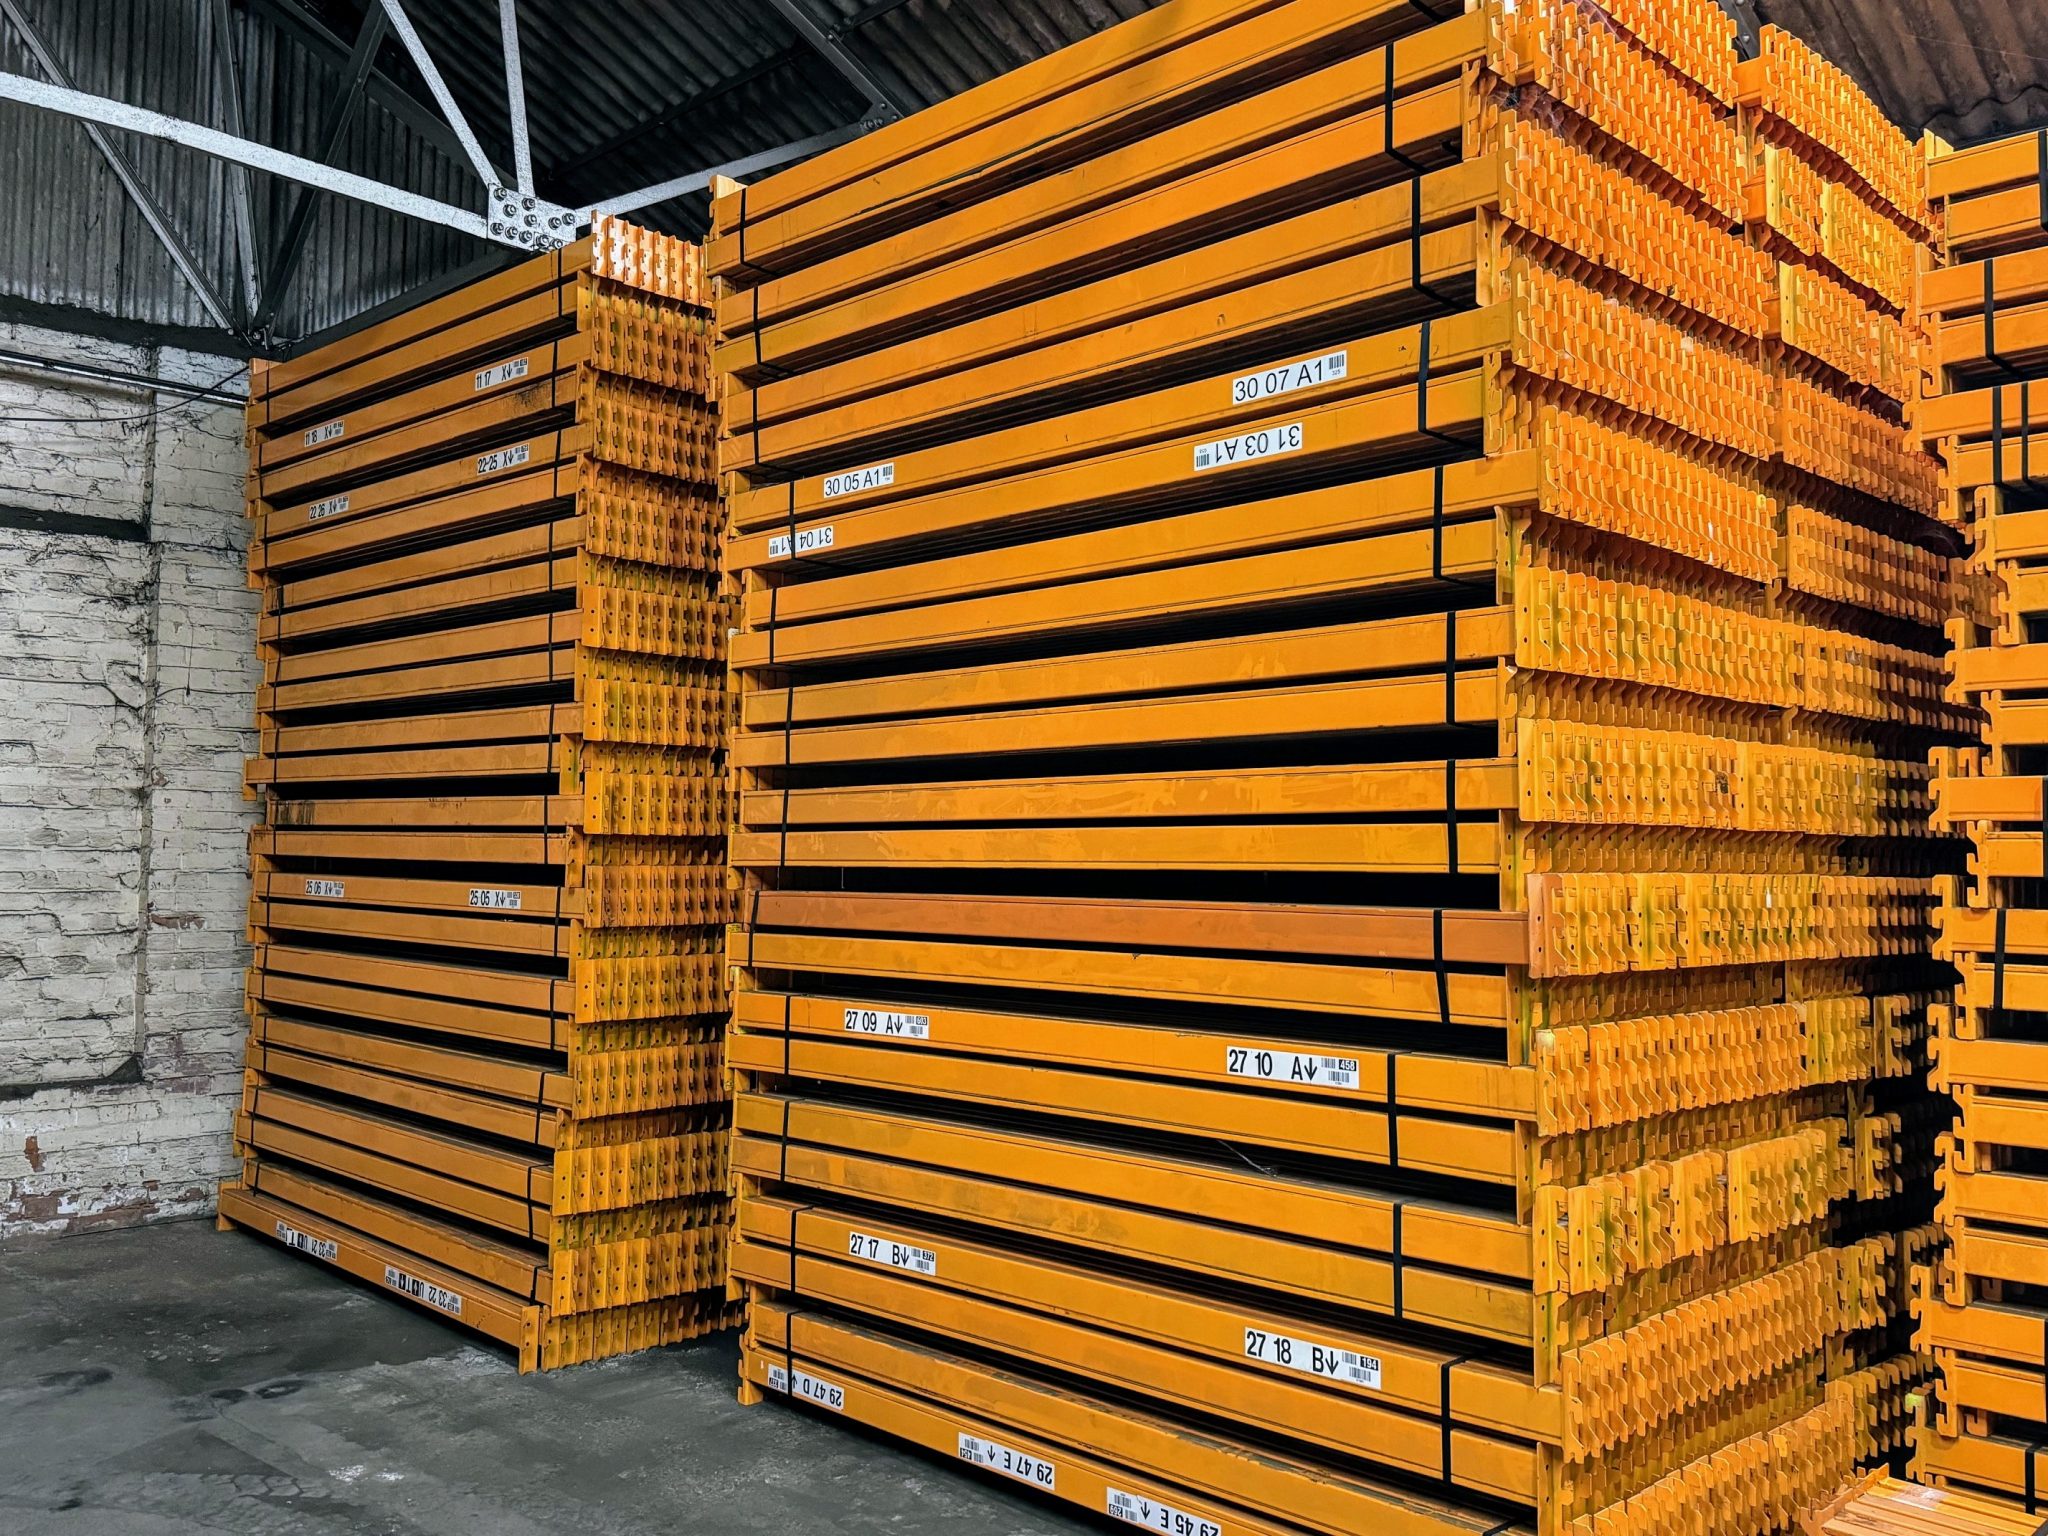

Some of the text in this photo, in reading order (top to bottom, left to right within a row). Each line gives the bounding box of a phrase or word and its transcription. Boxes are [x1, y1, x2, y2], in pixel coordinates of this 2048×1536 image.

[484, 370, 492, 387] 17
[501, 364, 507, 381] X
[1235, 359, 1322, 402] 30 07 A1
[1215, 425, 1300, 464] 31 03 A1
[502, 450, 508, 468] X
[825, 468, 880, 496] 30 05 A1
[309, 505, 317, 519] 22
[799, 531, 814, 550] 04
[819, 527, 832, 546] 31
[305, 880, 313, 894] 25
[470, 889, 479, 906] 25
[480, 890, 490, 906] 05
[494, 891, 500, 907] X
[845, 1010, 894, 1035] 27 09 A
[1229, 1049, 1304, 1081] 27 10 A
[1339, 1060, 1356, 1071] 458
[850, 1233, 900, 1266] 27 17 B
[438, 1289, 448, 1308] 33
[1246, 1330, 1325, 1374] 27 18 B
[1360, 1357, 1378, 1371] 194
[803, 1378, 842, 1407] 29 47 D
[1003, 1450, 1053, 1485] 29 47 E
[1160, 1508, 1169, 1529] E
[1175, 1514, 1194, 1536] 45
